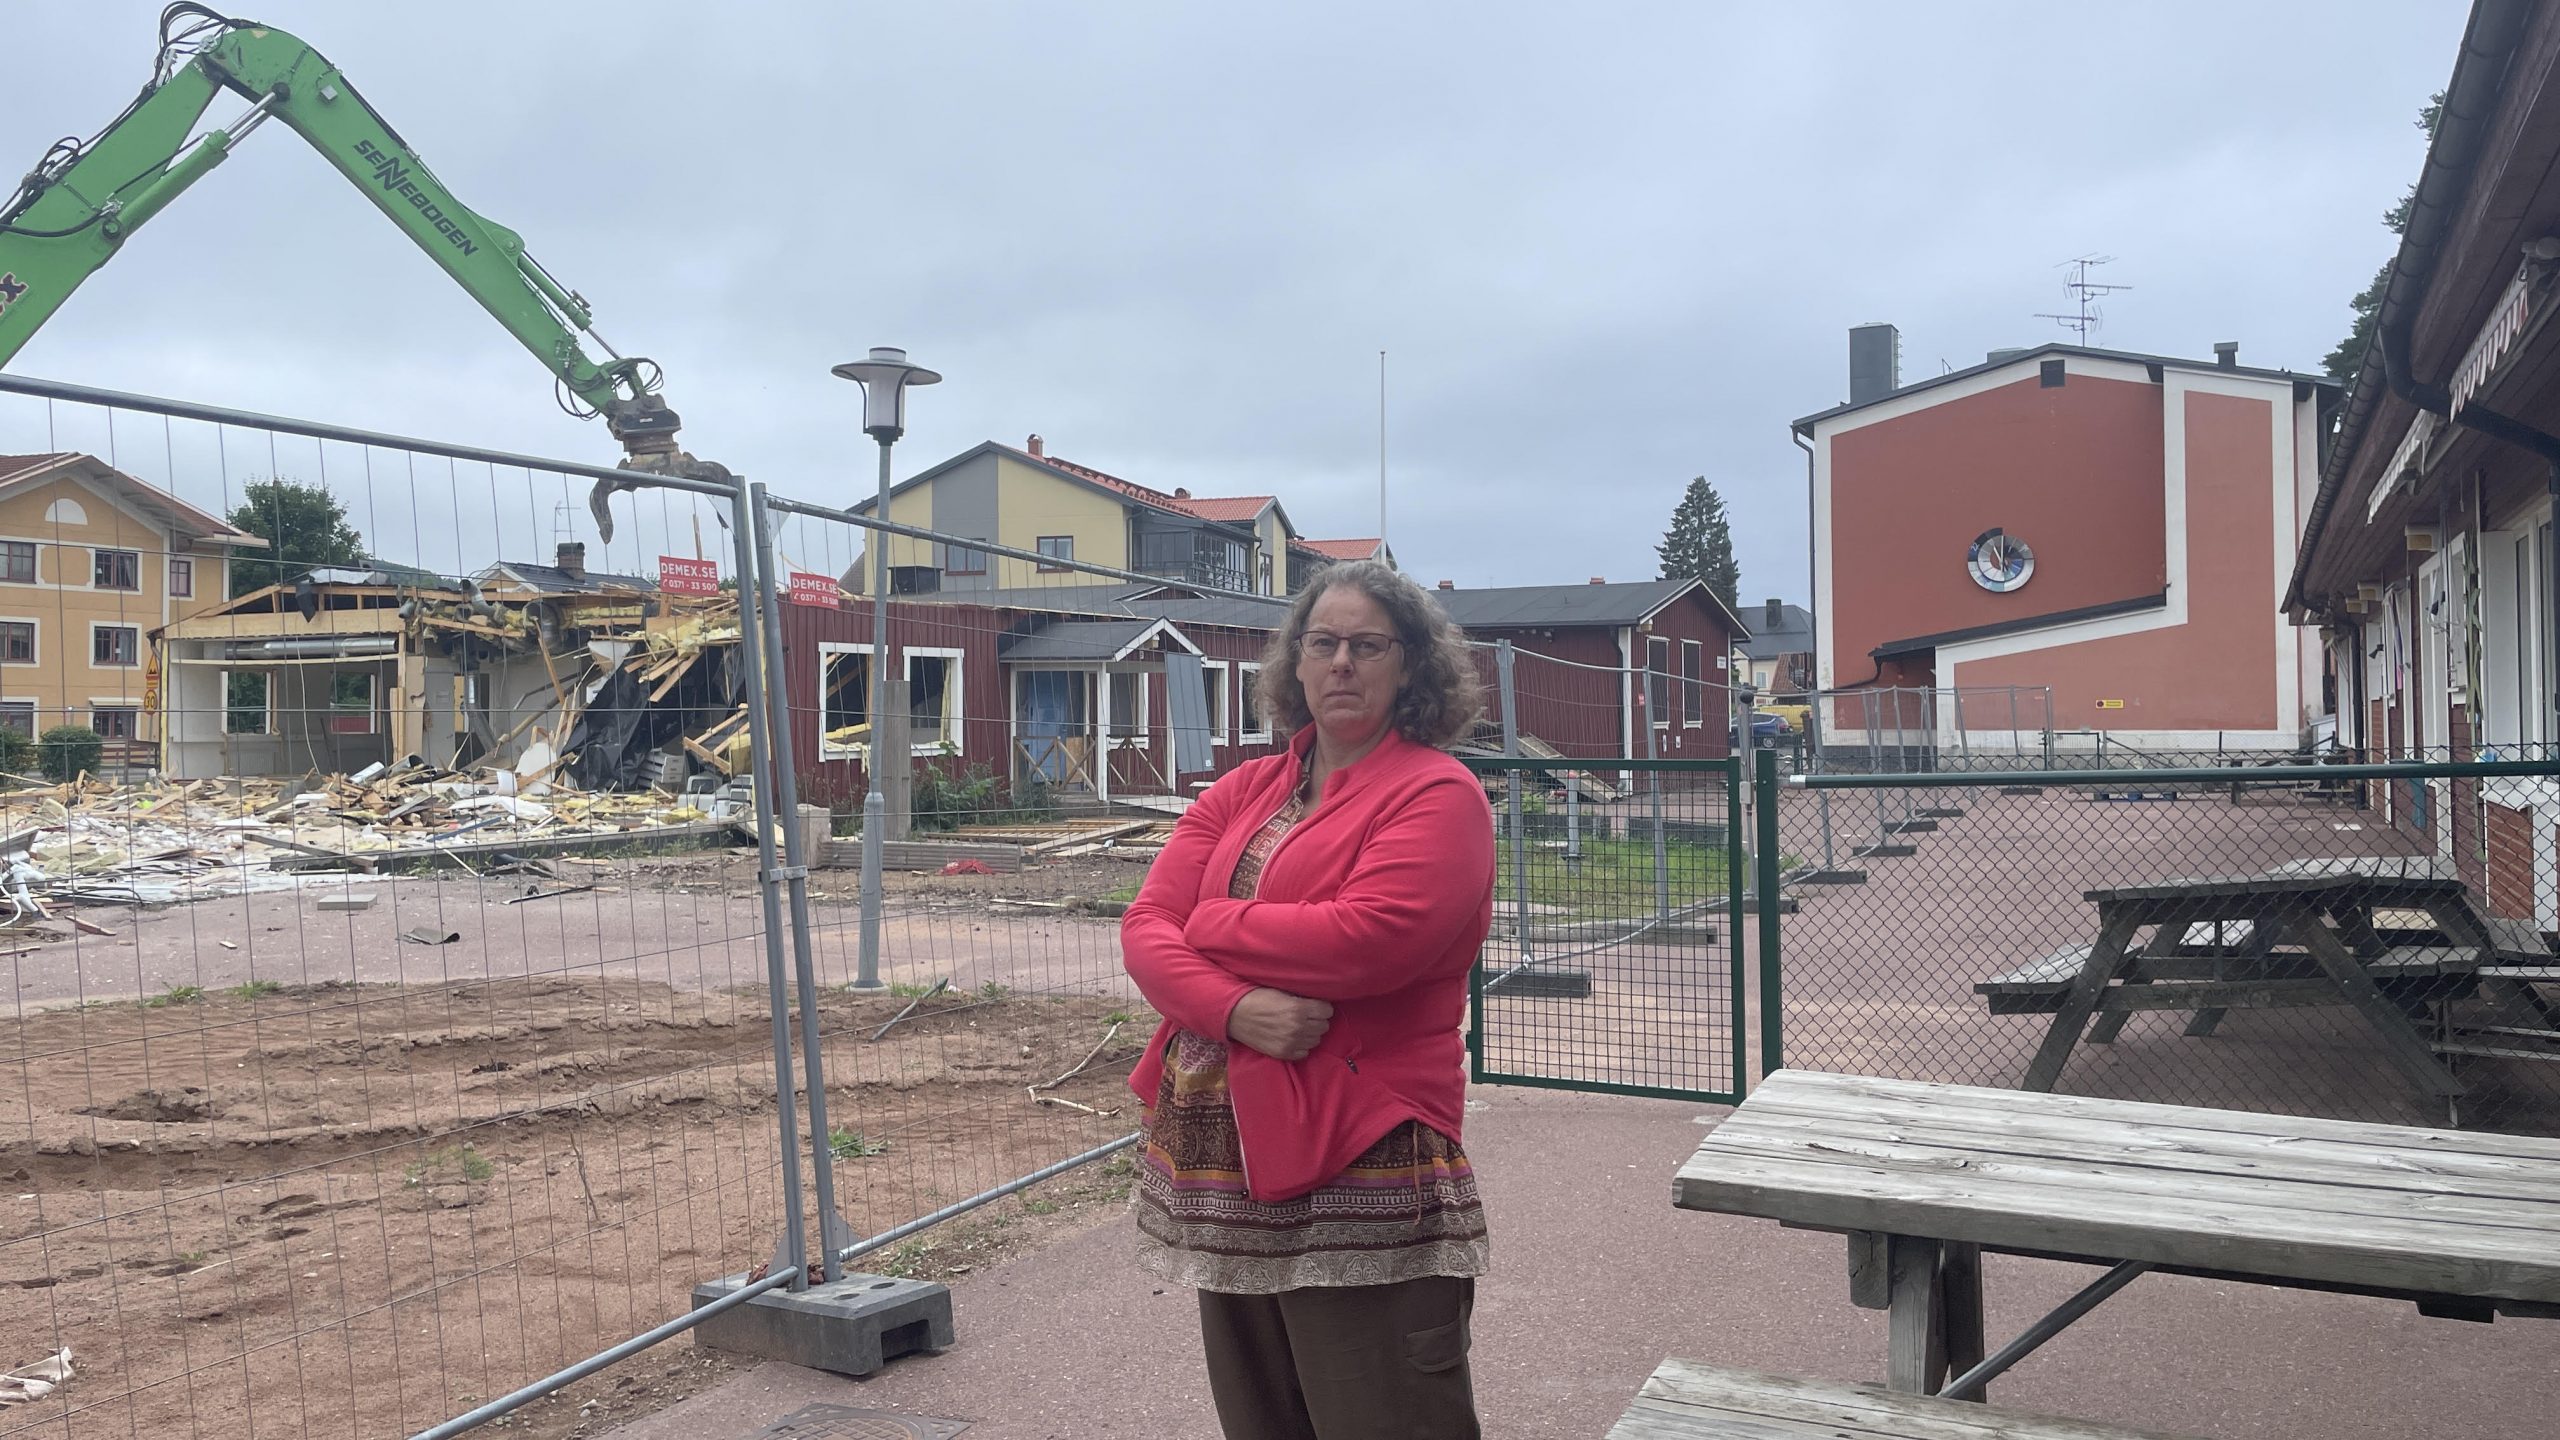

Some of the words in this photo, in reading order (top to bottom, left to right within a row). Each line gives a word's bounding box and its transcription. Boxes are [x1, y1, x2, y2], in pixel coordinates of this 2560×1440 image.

[353, 140, 479, 257] SENNEBOGEN
[661, 562, 717, 578] DEMEX.SE
[669, 579, 685, 589] 0371
[691, 581, 701, 590] 33
[703, 582, 717, 592] 500
[792, 577, 838, 594] DEMEX.SE
[800, 593, 817, 602] 0371
